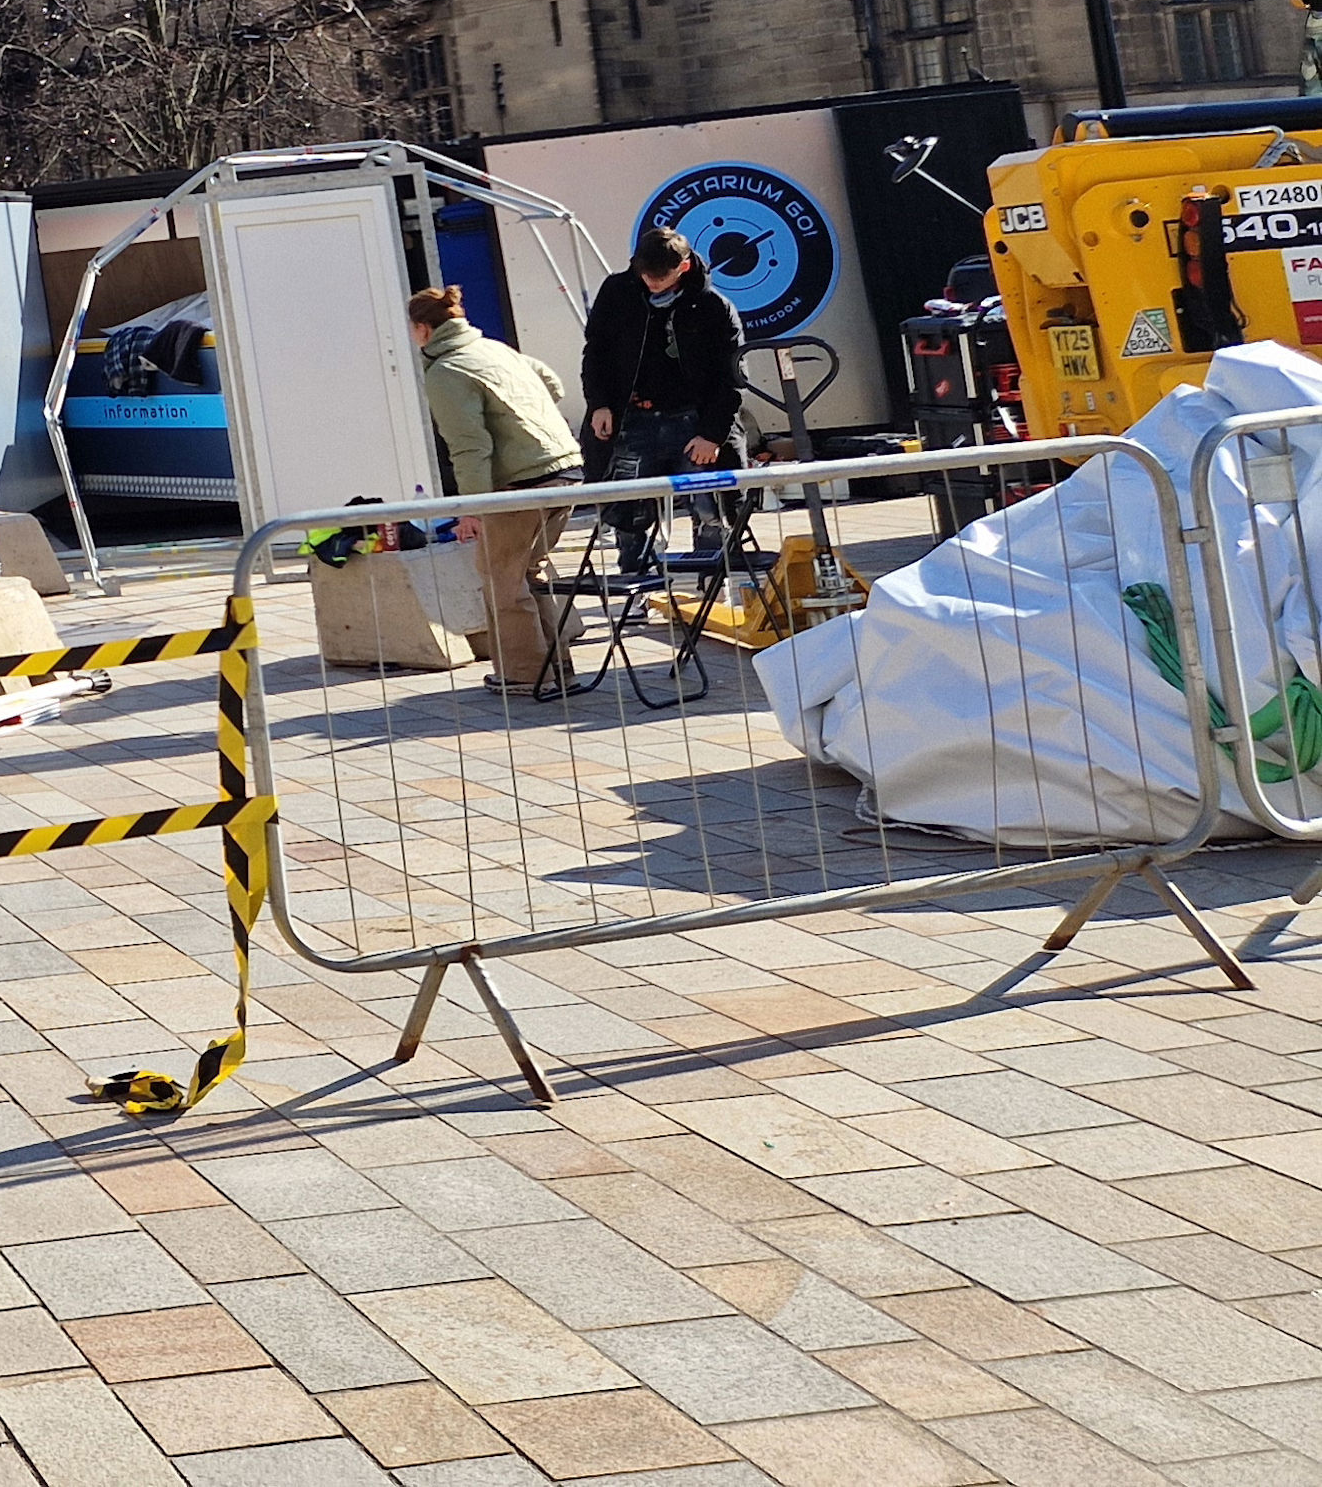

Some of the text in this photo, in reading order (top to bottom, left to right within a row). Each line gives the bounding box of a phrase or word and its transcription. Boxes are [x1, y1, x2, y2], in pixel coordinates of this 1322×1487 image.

[653, 174, 819, 238] ANETARIUM GO!
[1238, 184, 1322, 209] F12480
[1000, 204, 1047, 232] JCB
[745, 296, 803, 329] KINGDOM
[1052, 328, 1091, 353] YT25
[1061, 355, 1091, 377] HWK
[103, 403, 189, 419] information
